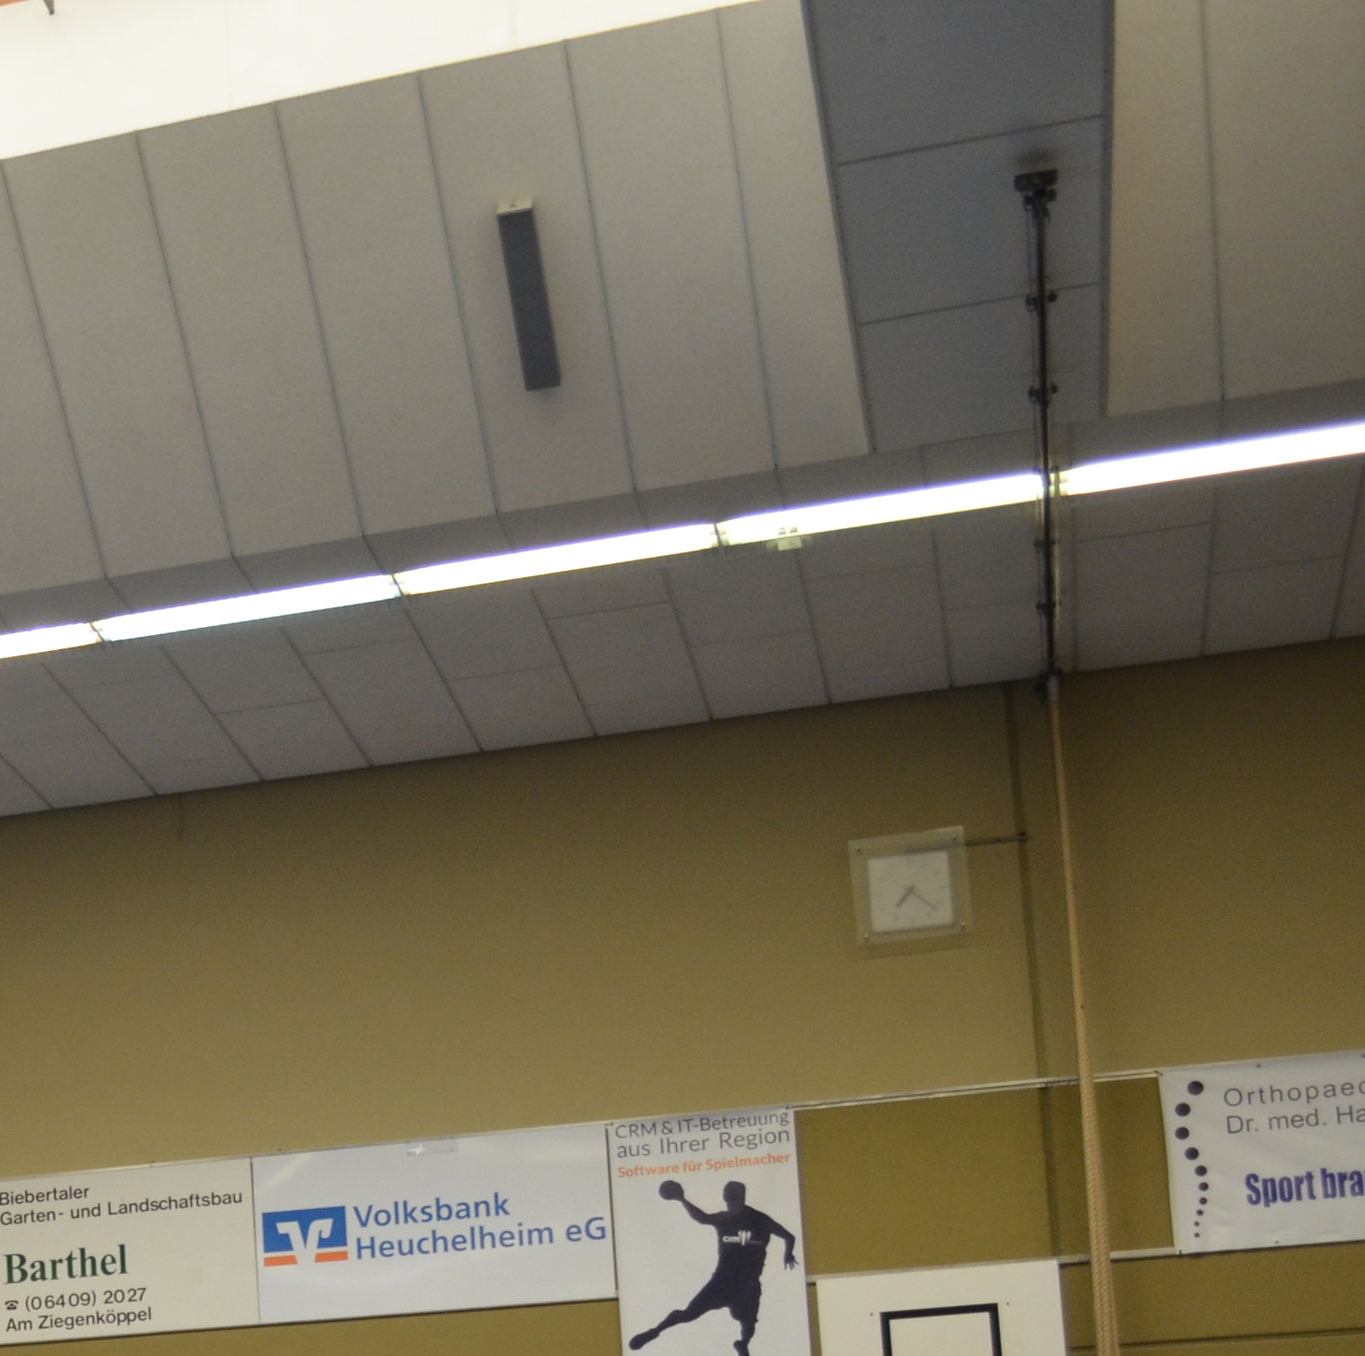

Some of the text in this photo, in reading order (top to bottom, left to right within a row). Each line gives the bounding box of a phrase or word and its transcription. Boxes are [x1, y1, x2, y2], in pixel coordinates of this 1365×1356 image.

[615, 1112, 789, 1138] CRM & IT-Betreuung
[1227, 1115, 1259, 1134] Dr.
[1269, 1108, 1327, 1130] med.
[617, 1129, 789, 1158] aus Ihrer Region
[617, 1153, 791, 1178] Software für Spielmacher
[0, 1186, 89, 1206] Biebertaler
[1245, 1168, 1365, 1208] Sport bra
[0, 1191, 243, 1226] Garten- und Landschaftsbau
[353, 1192, 510, 1228] Volksbank
[356, 1217, 606, 1259] Heuchelheim eG
[3, 1244, 127, 1284] Barthel
[25, 1288, 147, 1312] (06409) 2027
[6, 1306, 152, 1332] Am Ziegenköppel
